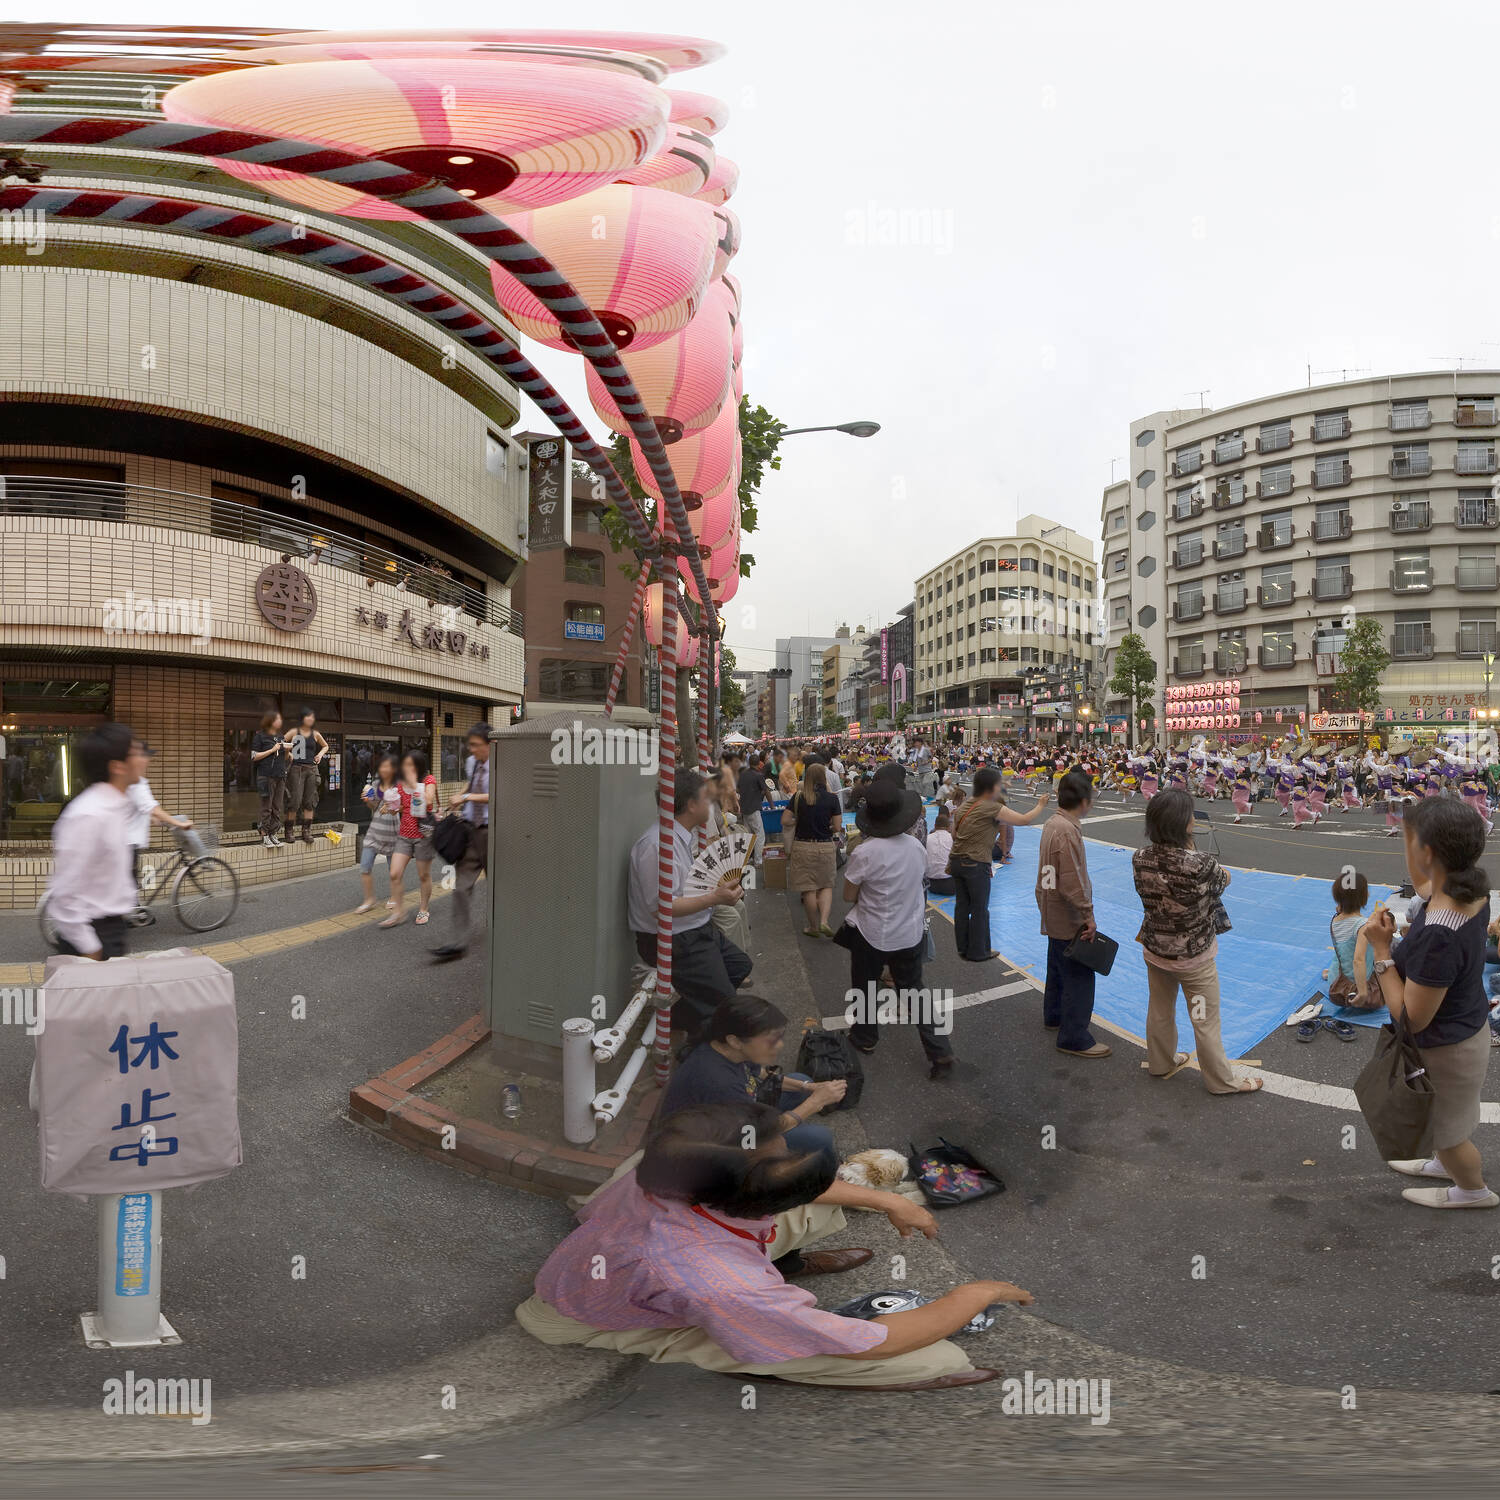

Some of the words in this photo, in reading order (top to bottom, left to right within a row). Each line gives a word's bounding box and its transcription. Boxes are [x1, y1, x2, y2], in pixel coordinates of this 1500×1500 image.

[538, 470, 560, 515] 大和田
[394, 608, 467, 656] 大和田
[108, 1021, 181, 1168] 休止中
